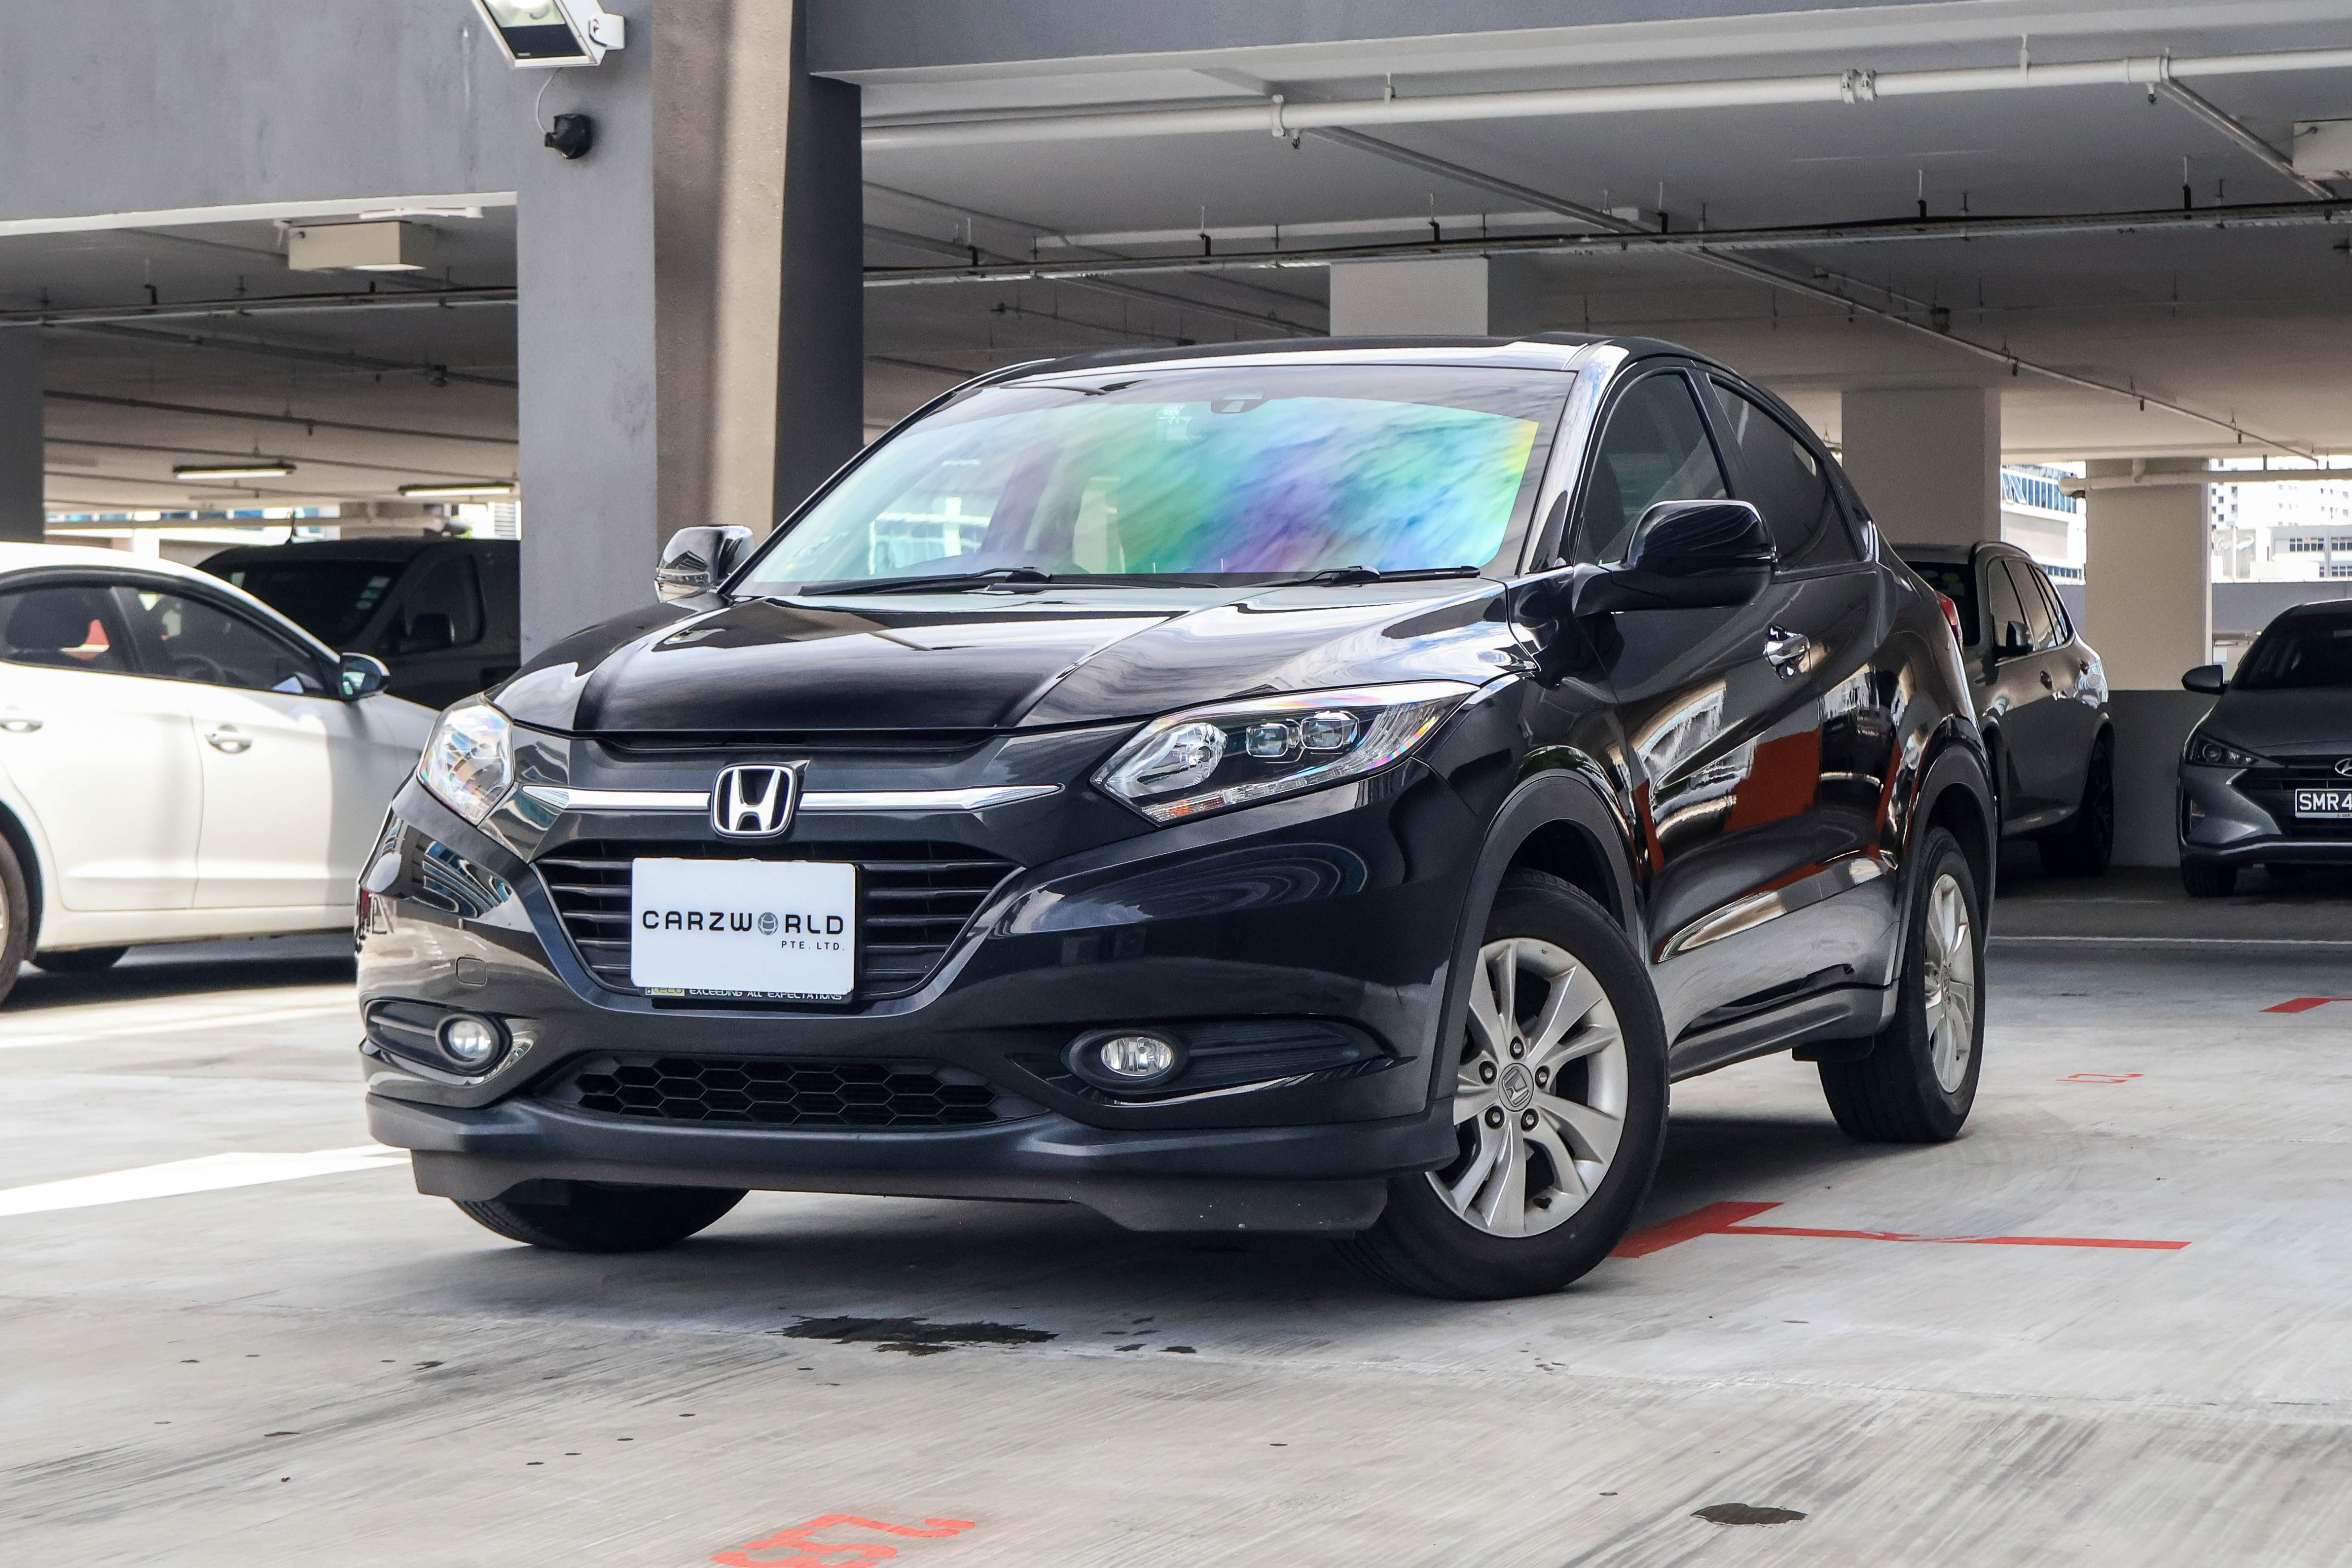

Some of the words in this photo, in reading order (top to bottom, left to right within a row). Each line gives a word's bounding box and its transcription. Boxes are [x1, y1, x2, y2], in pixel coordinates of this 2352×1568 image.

[2299, 793, 2352, 810] SMR4
[781, 941, 810, 949] PTE.
[817, 942, 845, 951] LTD.
